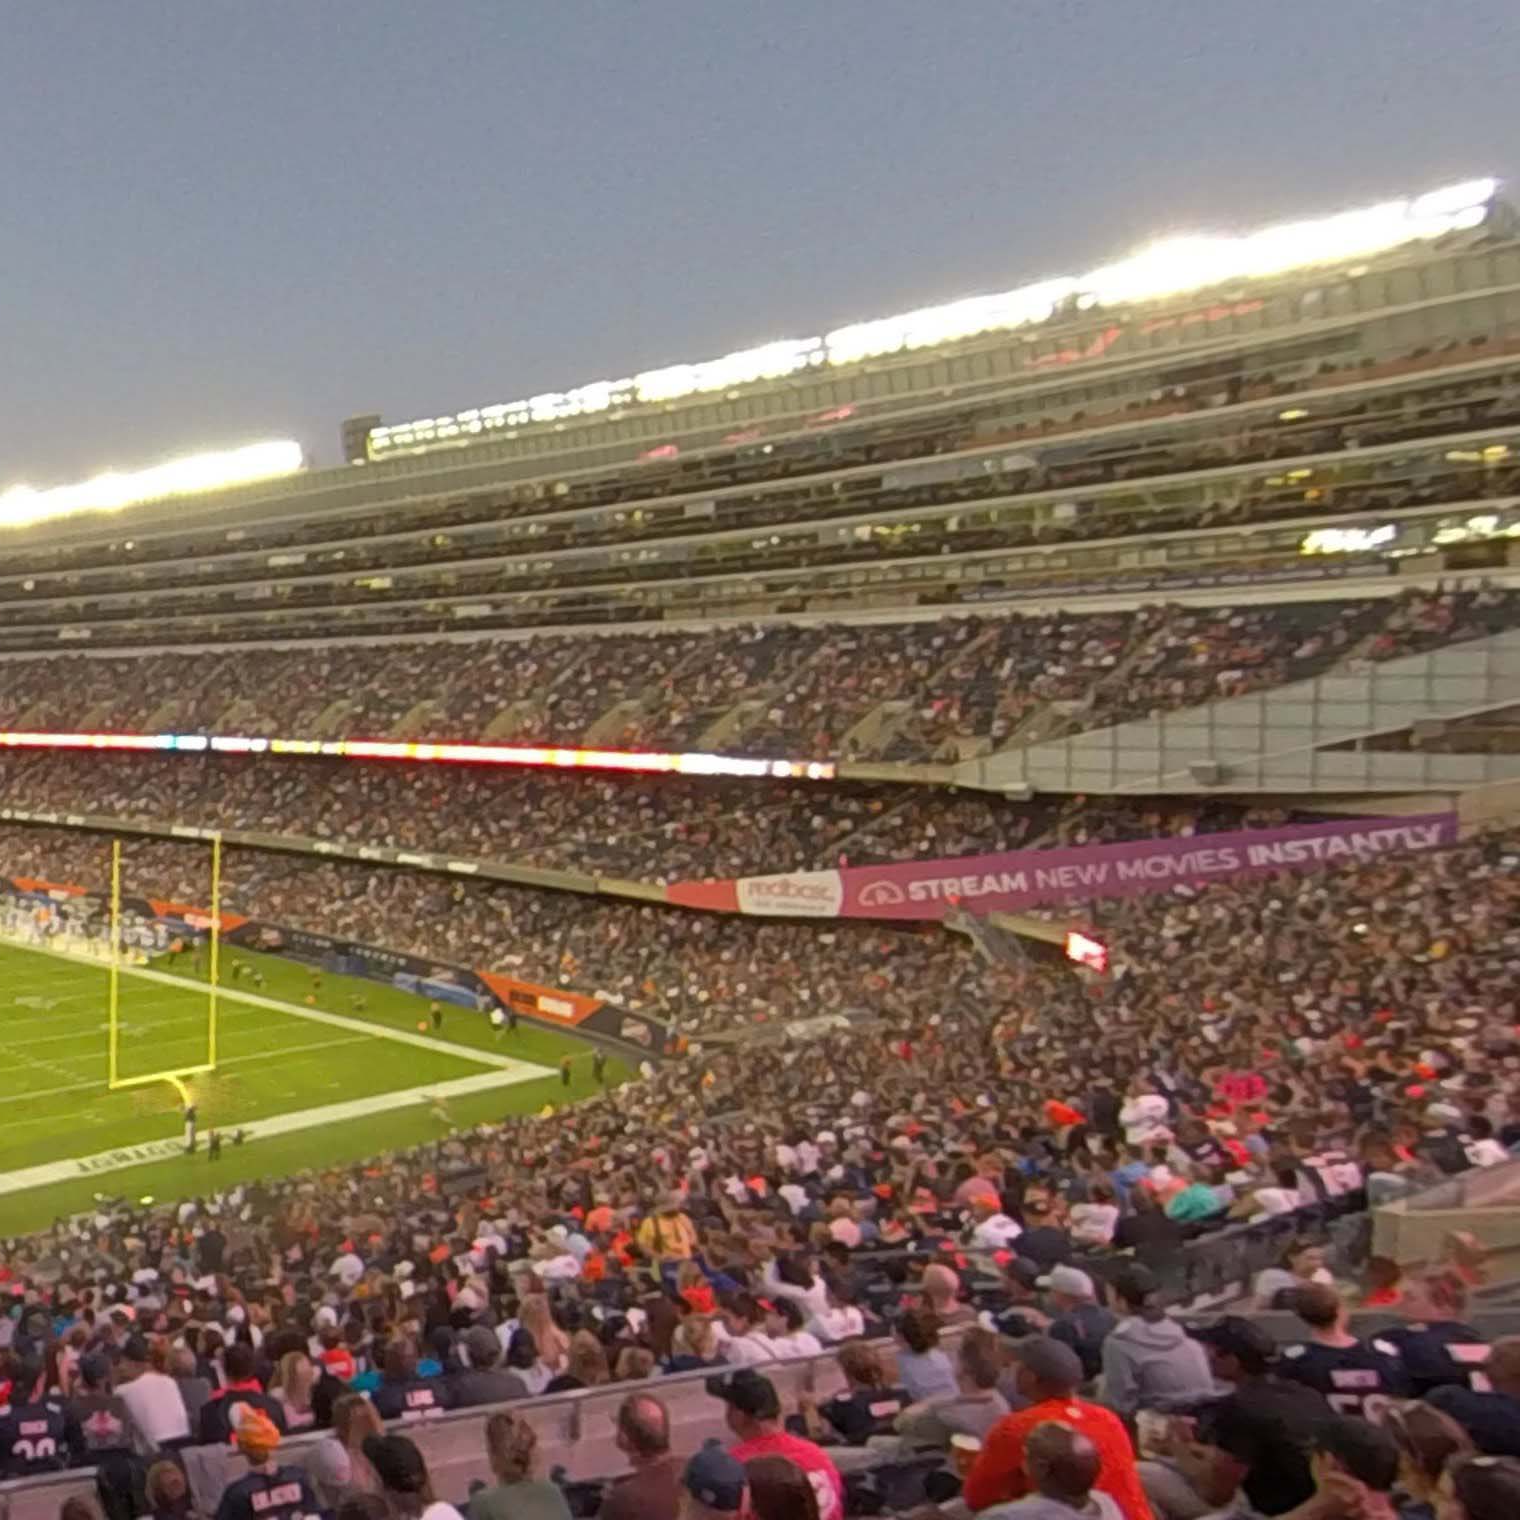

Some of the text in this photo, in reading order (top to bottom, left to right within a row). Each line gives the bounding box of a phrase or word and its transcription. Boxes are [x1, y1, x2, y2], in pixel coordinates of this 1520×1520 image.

[908, 823, 1443, 900] STREAM NEW MOVIES INSTANTLY
